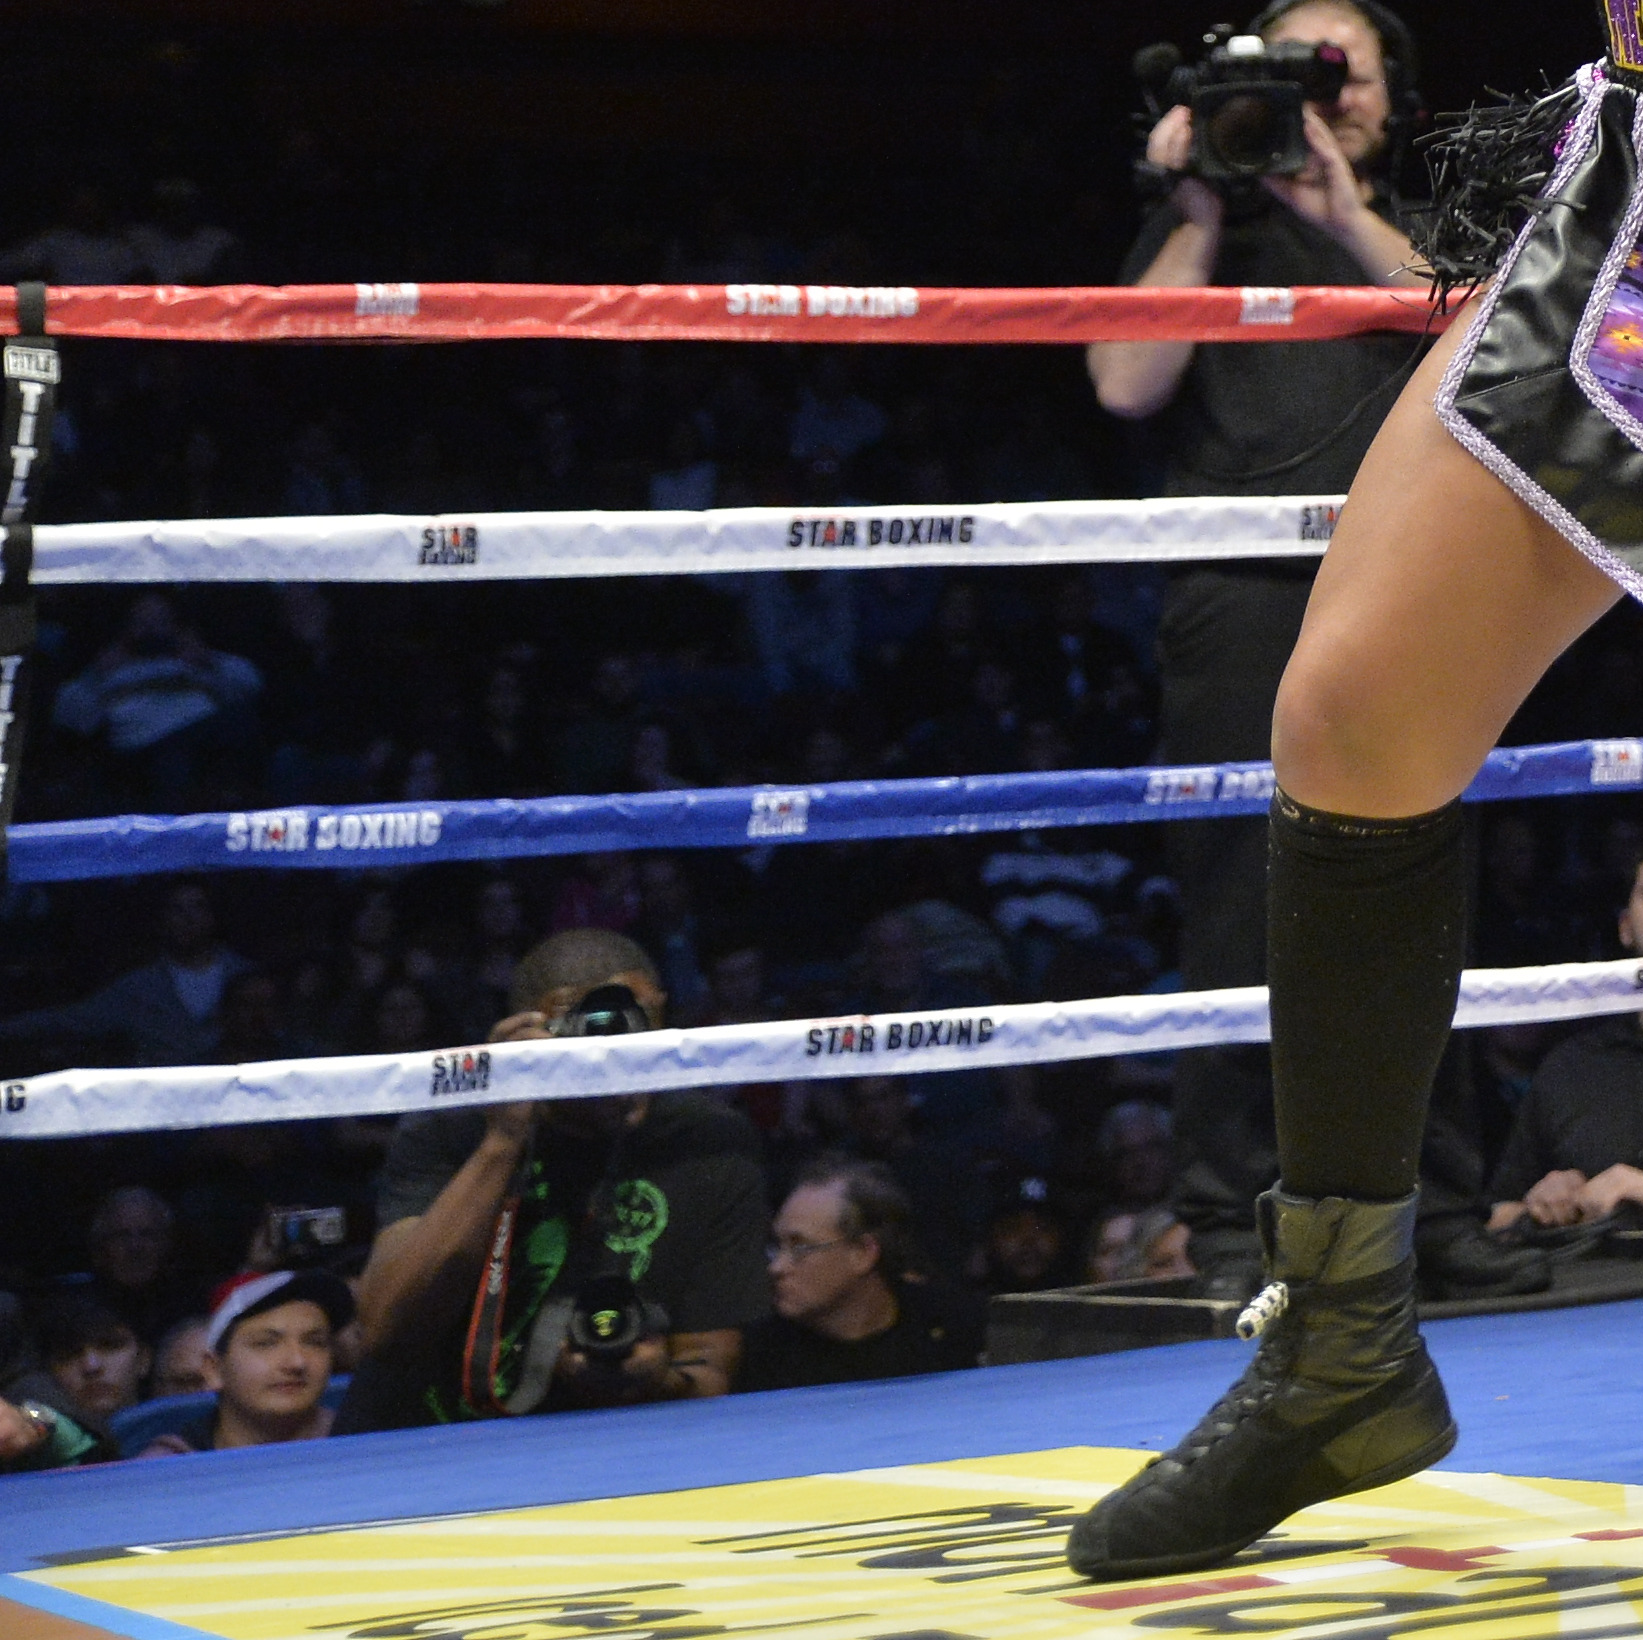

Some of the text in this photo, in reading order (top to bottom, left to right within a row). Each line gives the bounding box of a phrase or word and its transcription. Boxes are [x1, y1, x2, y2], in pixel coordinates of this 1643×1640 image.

[788, 515, 975, 548] STAR BOXING
[226, 810, 442, 851] STAR BOXING
[806, 1017, 995, 1057] STAR BOXING
[431, 1052, 490, 1077] STAR
